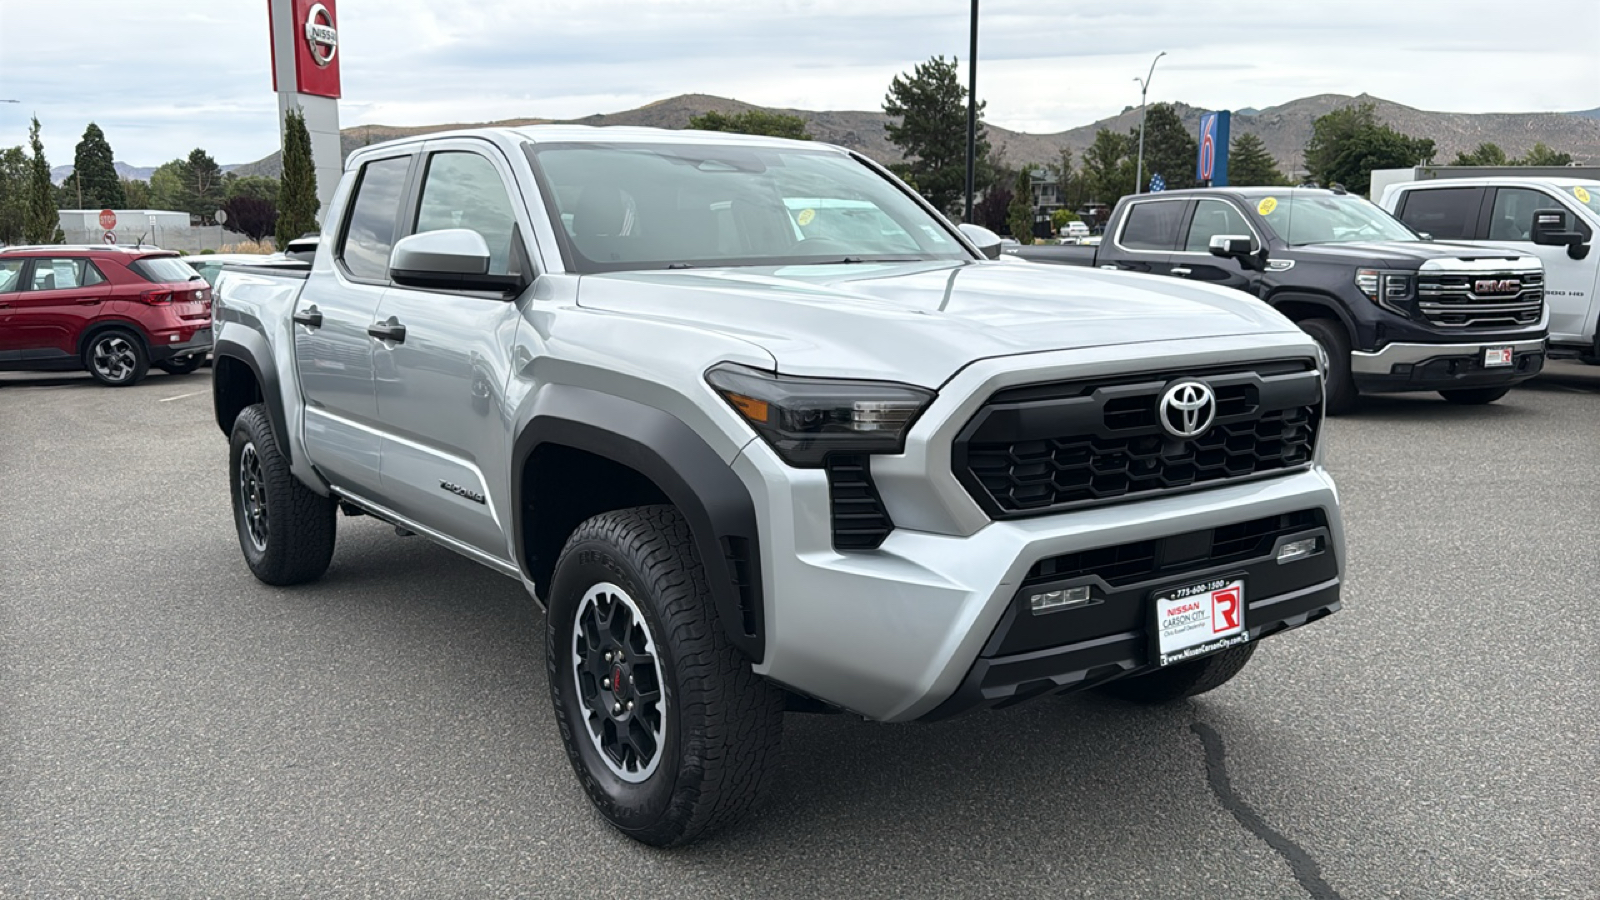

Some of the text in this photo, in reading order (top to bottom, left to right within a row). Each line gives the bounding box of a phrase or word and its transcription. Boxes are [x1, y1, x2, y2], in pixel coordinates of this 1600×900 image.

[1200, 114, 1215, 180] 6
[100, 214, 116, 225] STOP
[1475, 279, 1520, 292] GMC
[1176, 580, 1225, 598] 775-600-1500
[1166, 601, 1200, 617] NISSAN
[1214, 593, 1236, 629] R
[1162, 609, 1206, 629] CARSON CITY
